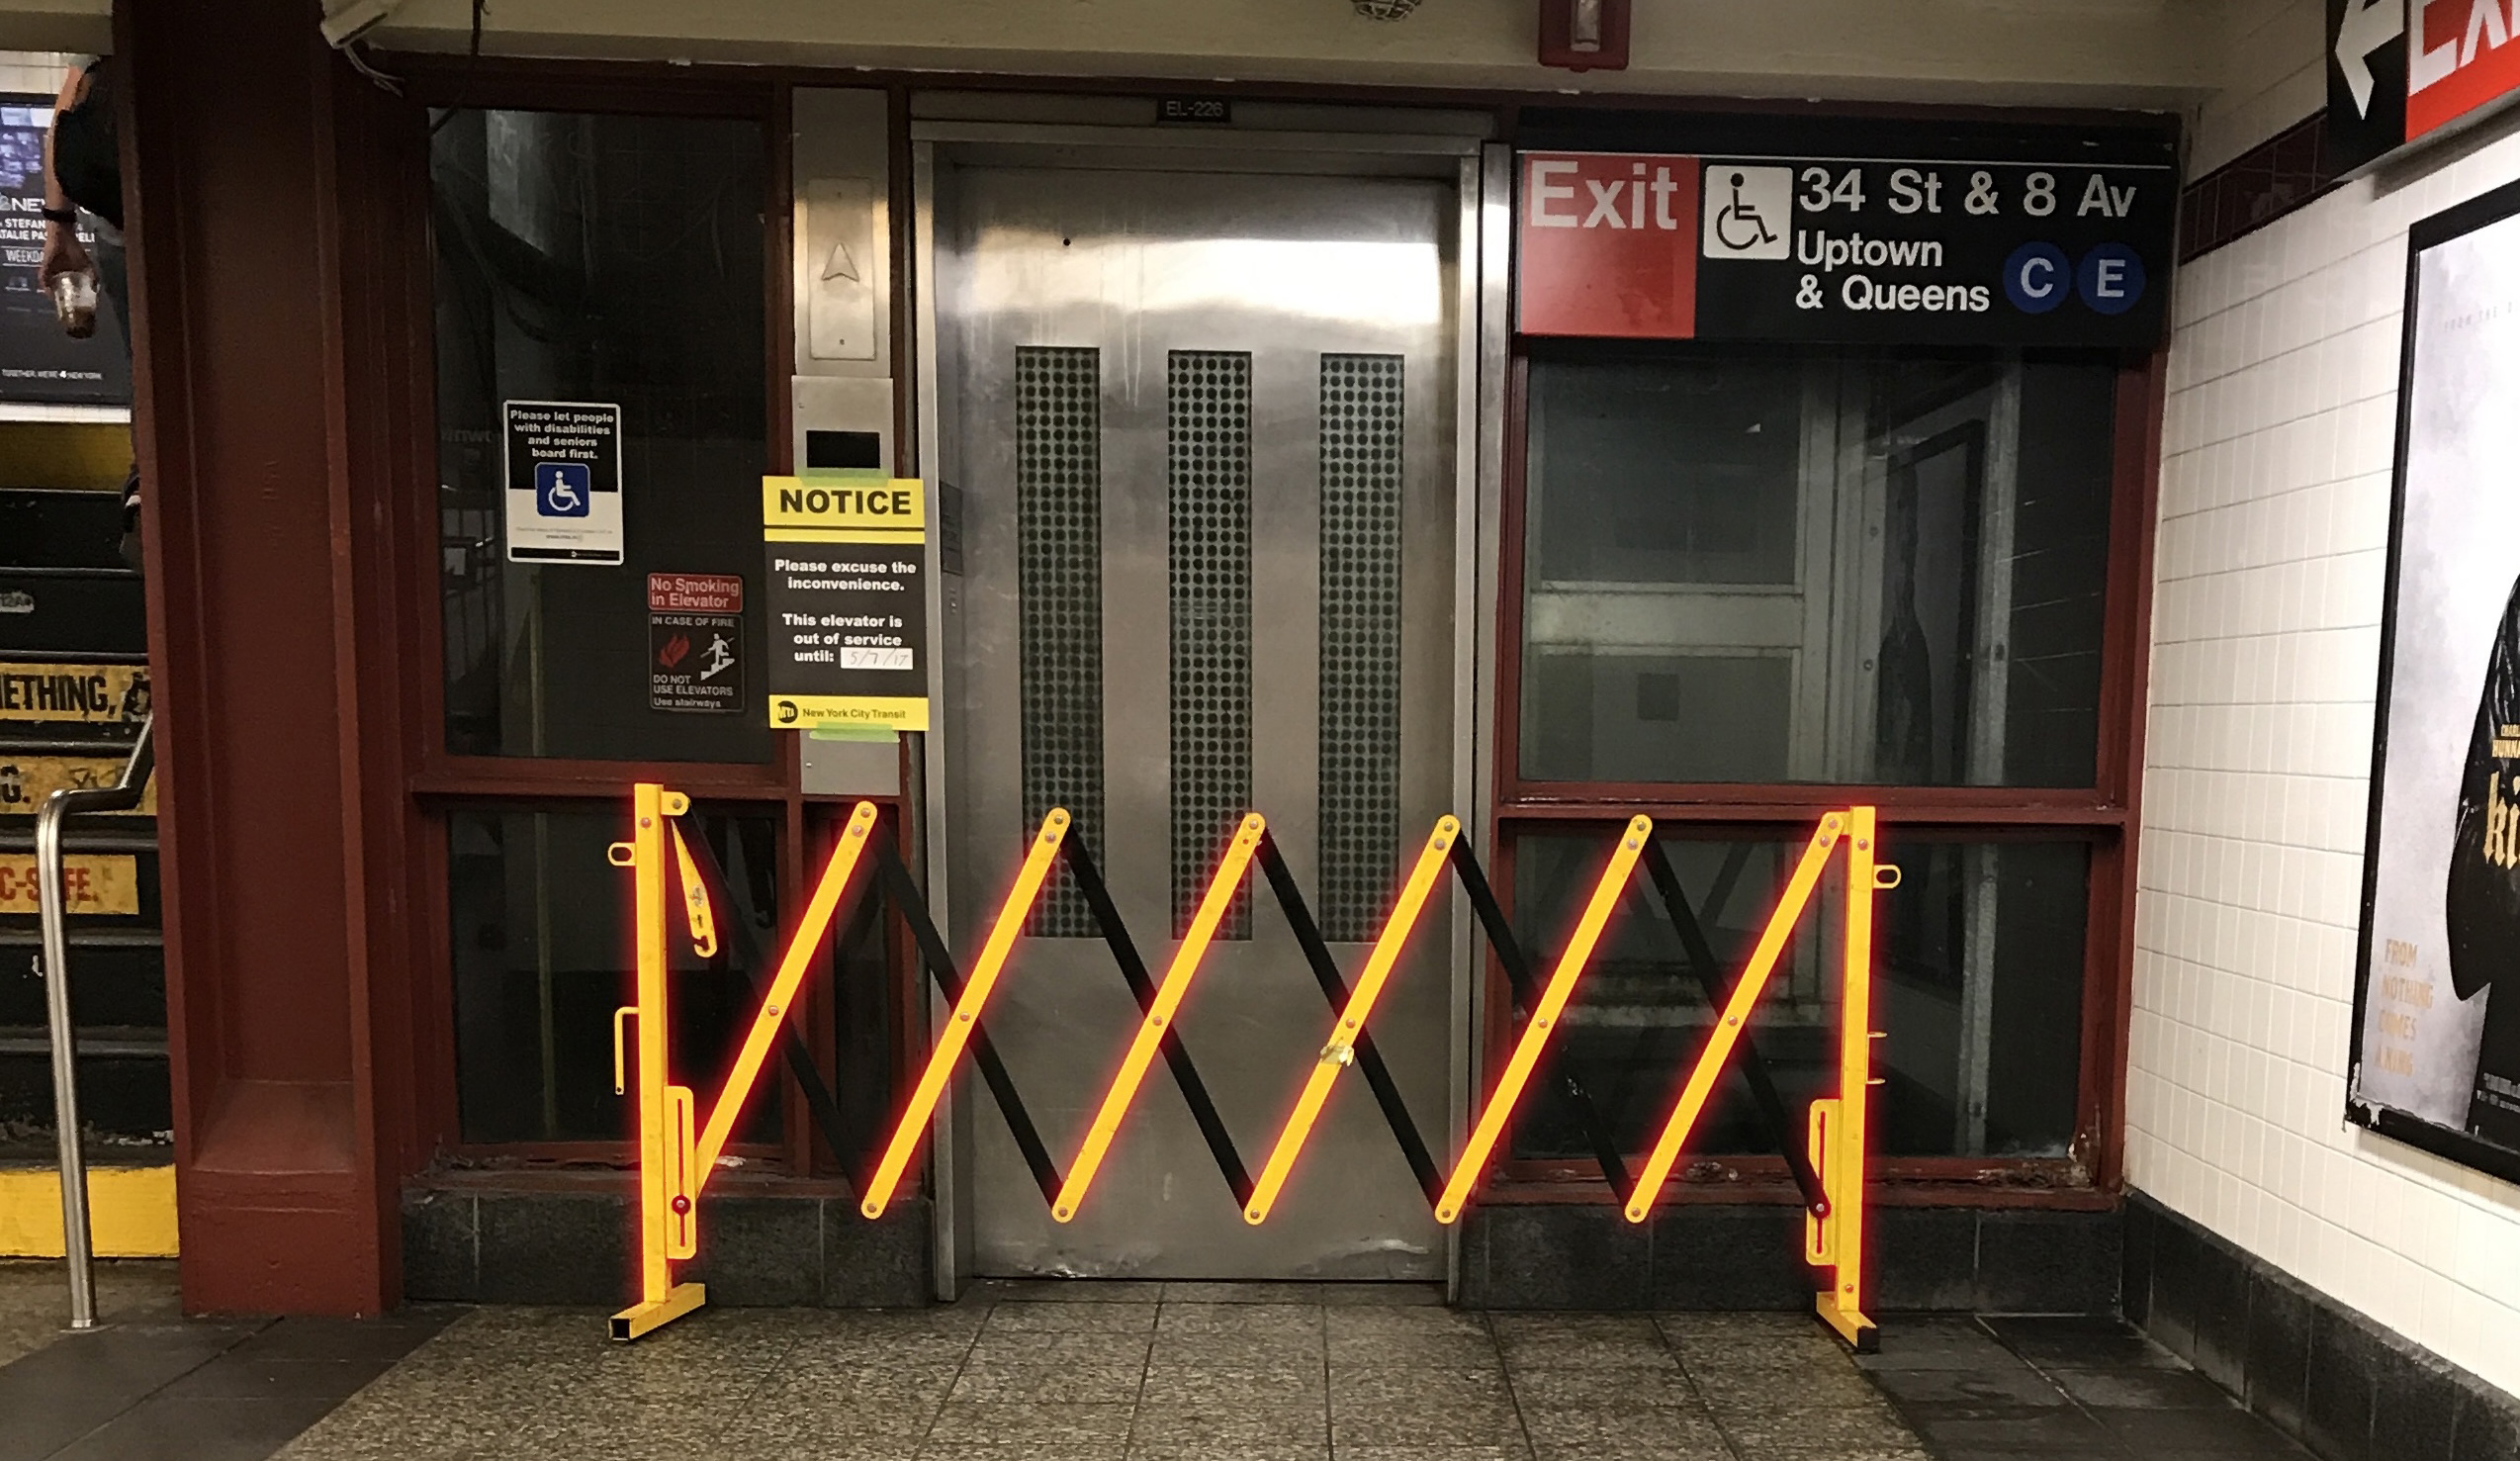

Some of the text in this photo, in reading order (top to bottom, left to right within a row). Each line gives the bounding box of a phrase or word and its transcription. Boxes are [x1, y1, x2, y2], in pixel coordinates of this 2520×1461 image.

[1166, 101, 1224, 117] EL-226
[1531, 160, 1677, 229] Exit
[1799, 167, 2137, 218] 34 St & 8 Av
[1797, 229, 1943, 272] Uptown
[2021, 257, 2126, 298] C E
[1795, 274, 1990, 313] & Queens
[510, 410, 613, 423] Please let people
[514, 423, 610, 434] with disabilities
[528, 435, 597, 446] and seniors
[531, 447, 598, 459] board first.
[779, 489, 912, 515] NOTICE
[774, 559, 917, 574] Please excuse the
[651, 577, 739, 596] No Smoking
[787, 577, 906, 592] inconvenience.
[652, 593, 729, 607] in Elevator
[652, 616, 735, 627] IN CASE OF FIRE
[781, 613, 903, 628] This elevator is
[793, 632, 903, 646] out of service
[794, 650, 835, 663] until:
[653, 675, 691, 685] DO NOT
[0, 674, 118, 718] ETHING,
[653, 685, 734, 696] USE ELEVATORS
[654, 697, 673, 706] Use
[802, 708, 907, 720] New York City Transit
